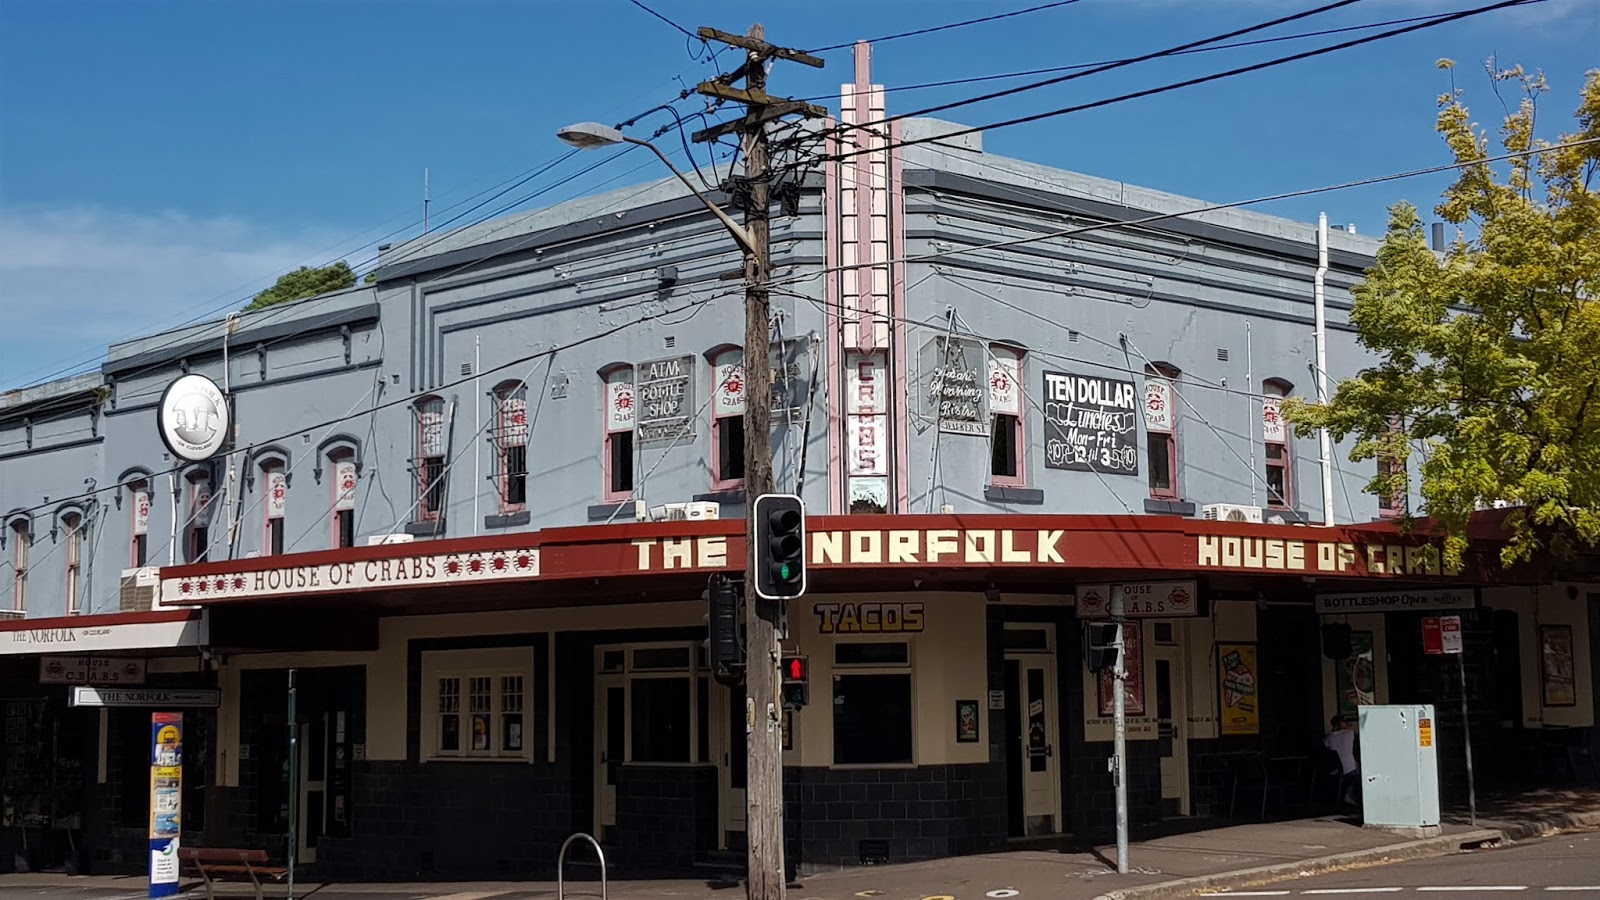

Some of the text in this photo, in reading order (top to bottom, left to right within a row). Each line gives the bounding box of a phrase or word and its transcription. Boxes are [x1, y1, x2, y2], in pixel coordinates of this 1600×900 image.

[650, 361, 680, 378] ATM
[642, 382, 684, 400] BOTTLE
[1046, 374, 1134, 410] TEN DOLLAR
[650, 400, 678, 417] SHOP
[859, 362, 876, 470] CRABS
[940, 401, 976, 418] Bistro
[1064, 402, 1120, 432] Lunches
[1066, 428, 1117, 448] Mon-Fri
[1101, 448, 1110, 466] 3
[631, 530, 1066, 570] THE NORFOLK
[1198, 535, 1460, 576] HOUSE OF CRAB
[254, 556, 436, 590] HOUSE OF CRABS
[1124, 585, 1152, 594] OUSE
[1324, 596, 1400, 608] BOTTLESHOP
[1401, 594, 1428, 606] Open
[814, 602, 924, 634] TACOS
[12, 631, 26, 642] THE
[28, 628, 76, 643] NORFOLK
[102, 692, 121, 702] THE
[124, 693, 170, 702] NORFOLK
